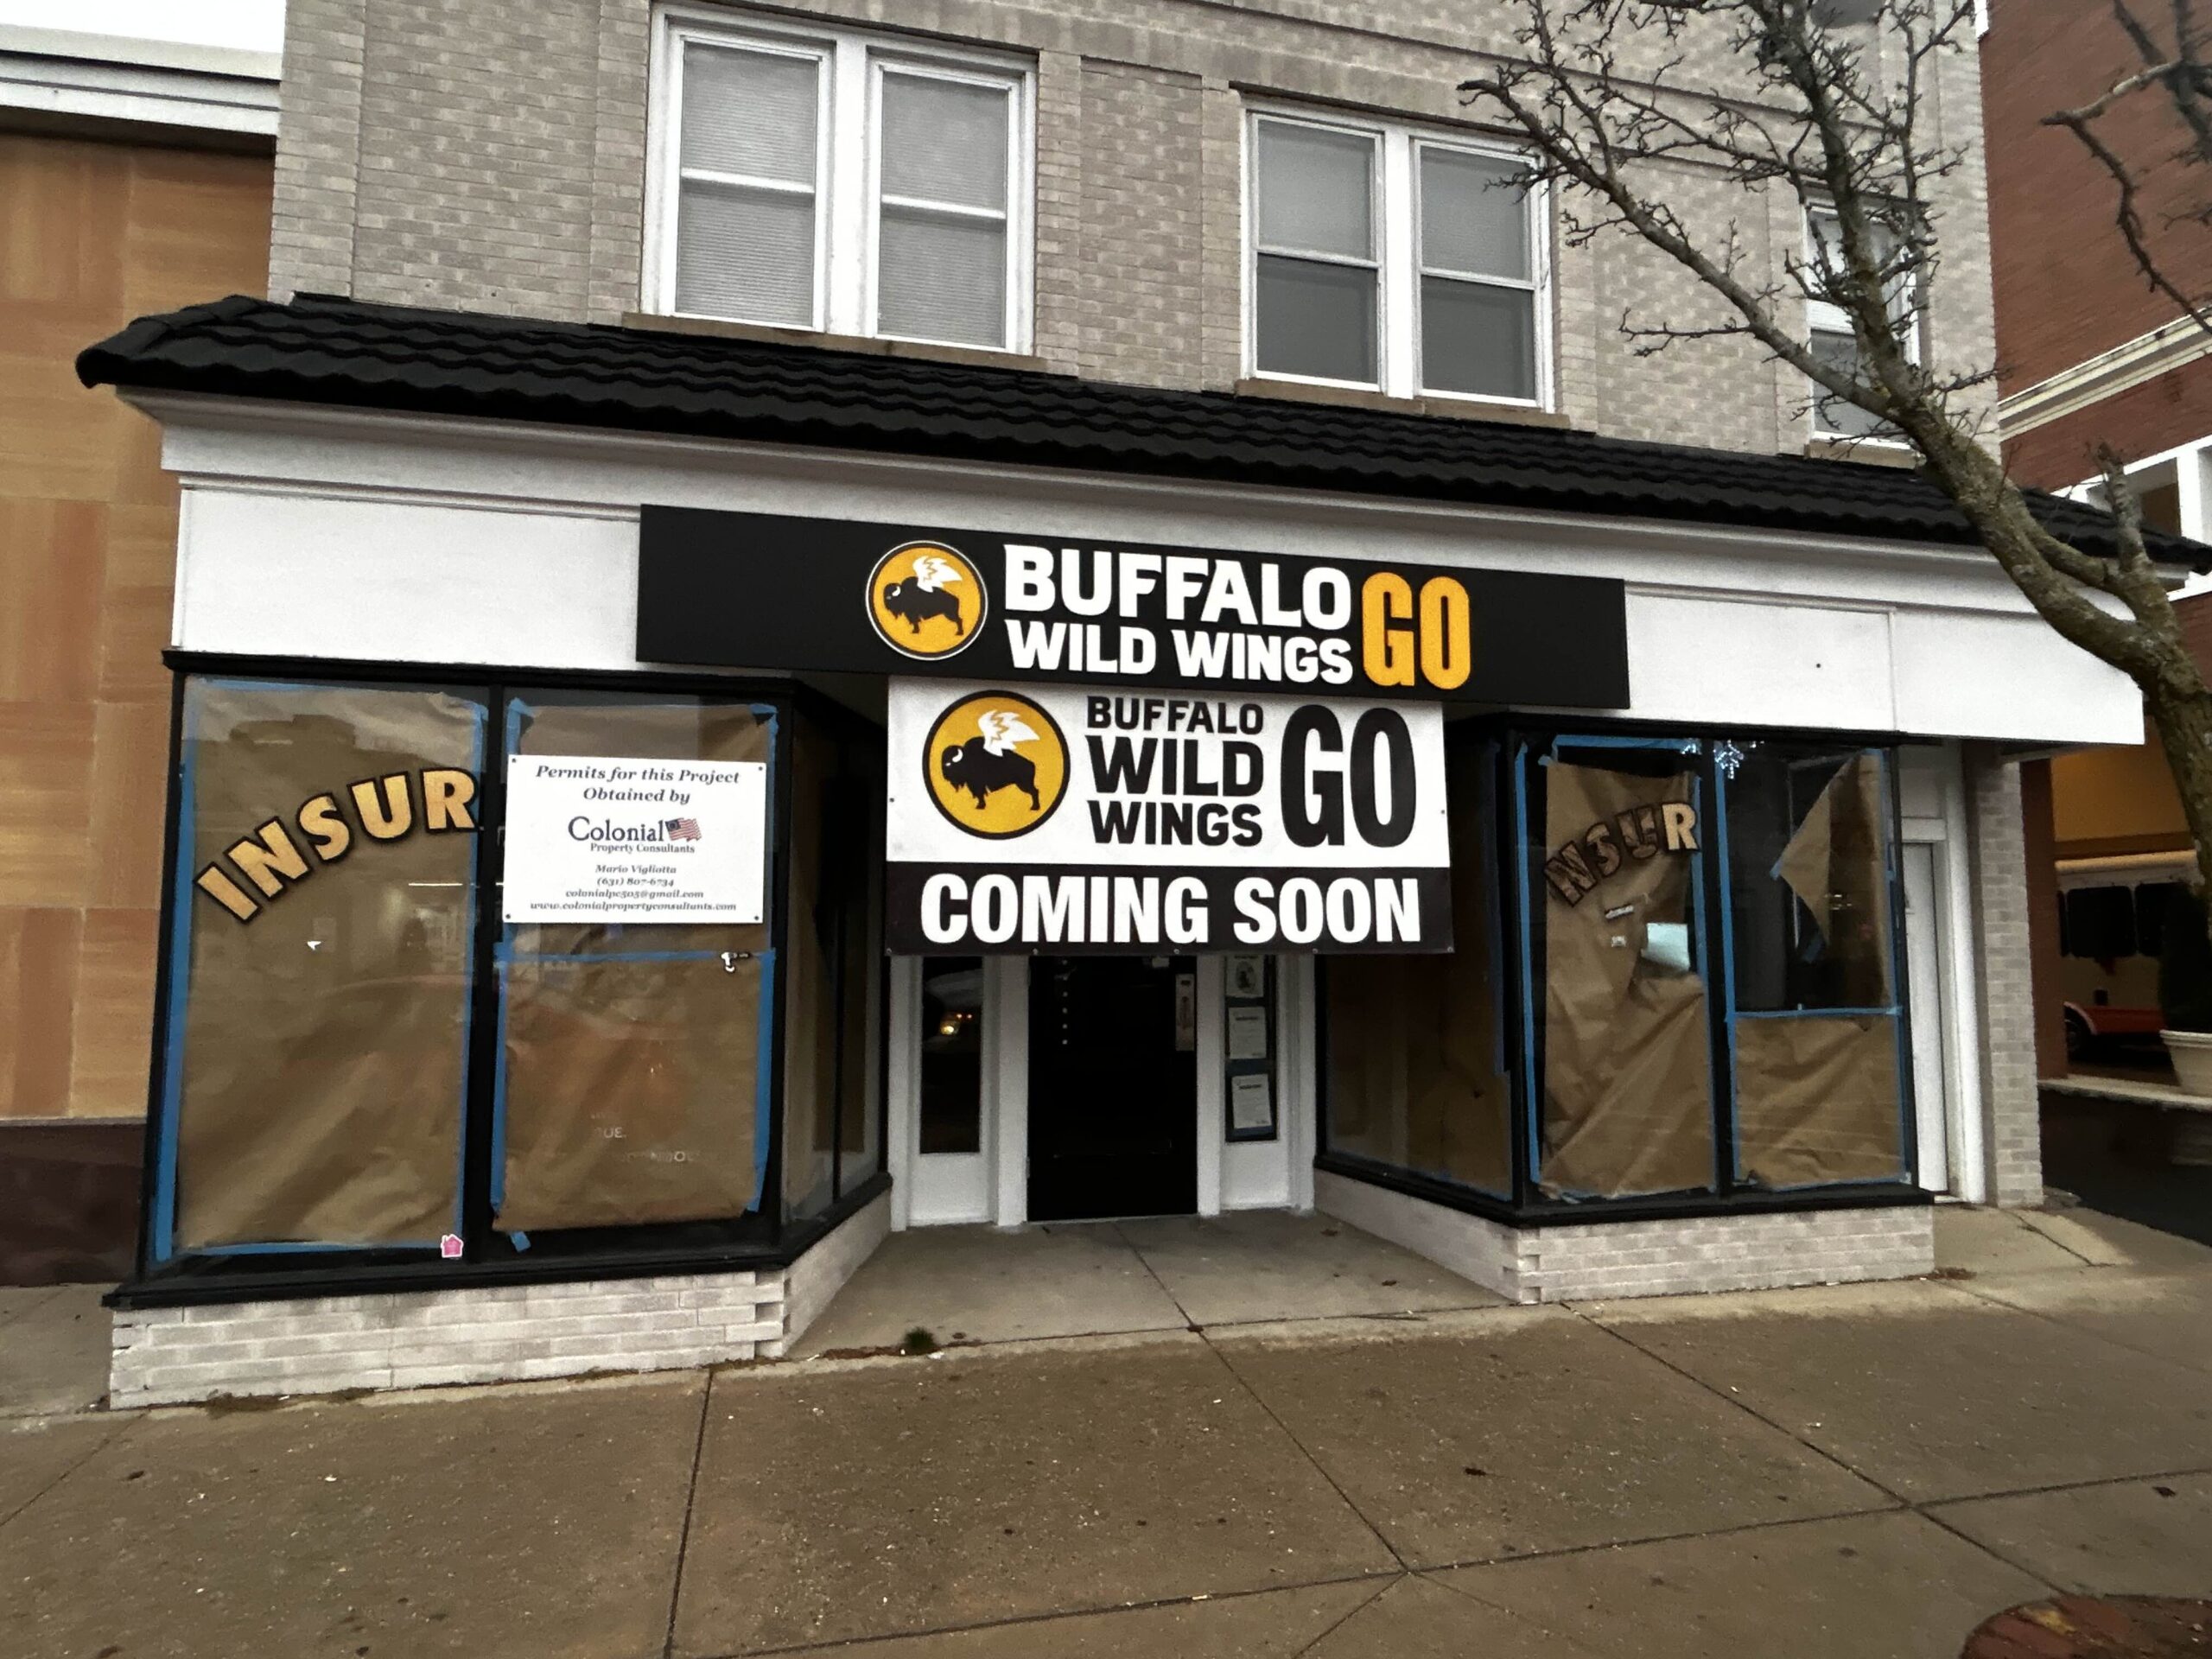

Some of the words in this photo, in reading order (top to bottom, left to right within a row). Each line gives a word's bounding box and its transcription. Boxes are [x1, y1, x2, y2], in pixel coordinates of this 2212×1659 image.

[1004, 544, 1351, 630] BUFFALO
[1005, 619, 1157, 676] WILD
[1171, 629, 1353, 684] WINGS
[1362, 572, 1471, 690] GO
[1086, 696, 1264, 735] BUFFALO
[536, 765, 606, 779] Permits
[607, 767, 638, 782] for
[641, 767, 674, 781] this
[678, 769, 740, 785] Project
[1086, 735, 1264, 797] WILD
[1280, 704, 1417, 848] GO
[583, 787, 664, 803] Obtained
[670, 789, 690, 804] by
[568, 816, 664, 842] Colonial
[1088, 800, 1264, 847] WINGS
[193, 766, 480, 925] INSUR
[590, 842, 633, 854] Property
[636, 843, 695, 854] Consultants
[595, 864, 628, 874] Mario
[597, 877, 624, 887] (631)
[530, 901, 737, 912] www.colonialpropertyconsultants.com
[920, 873, 1209, 944] COMING
[1233, 877, 1421, 943] SOON
